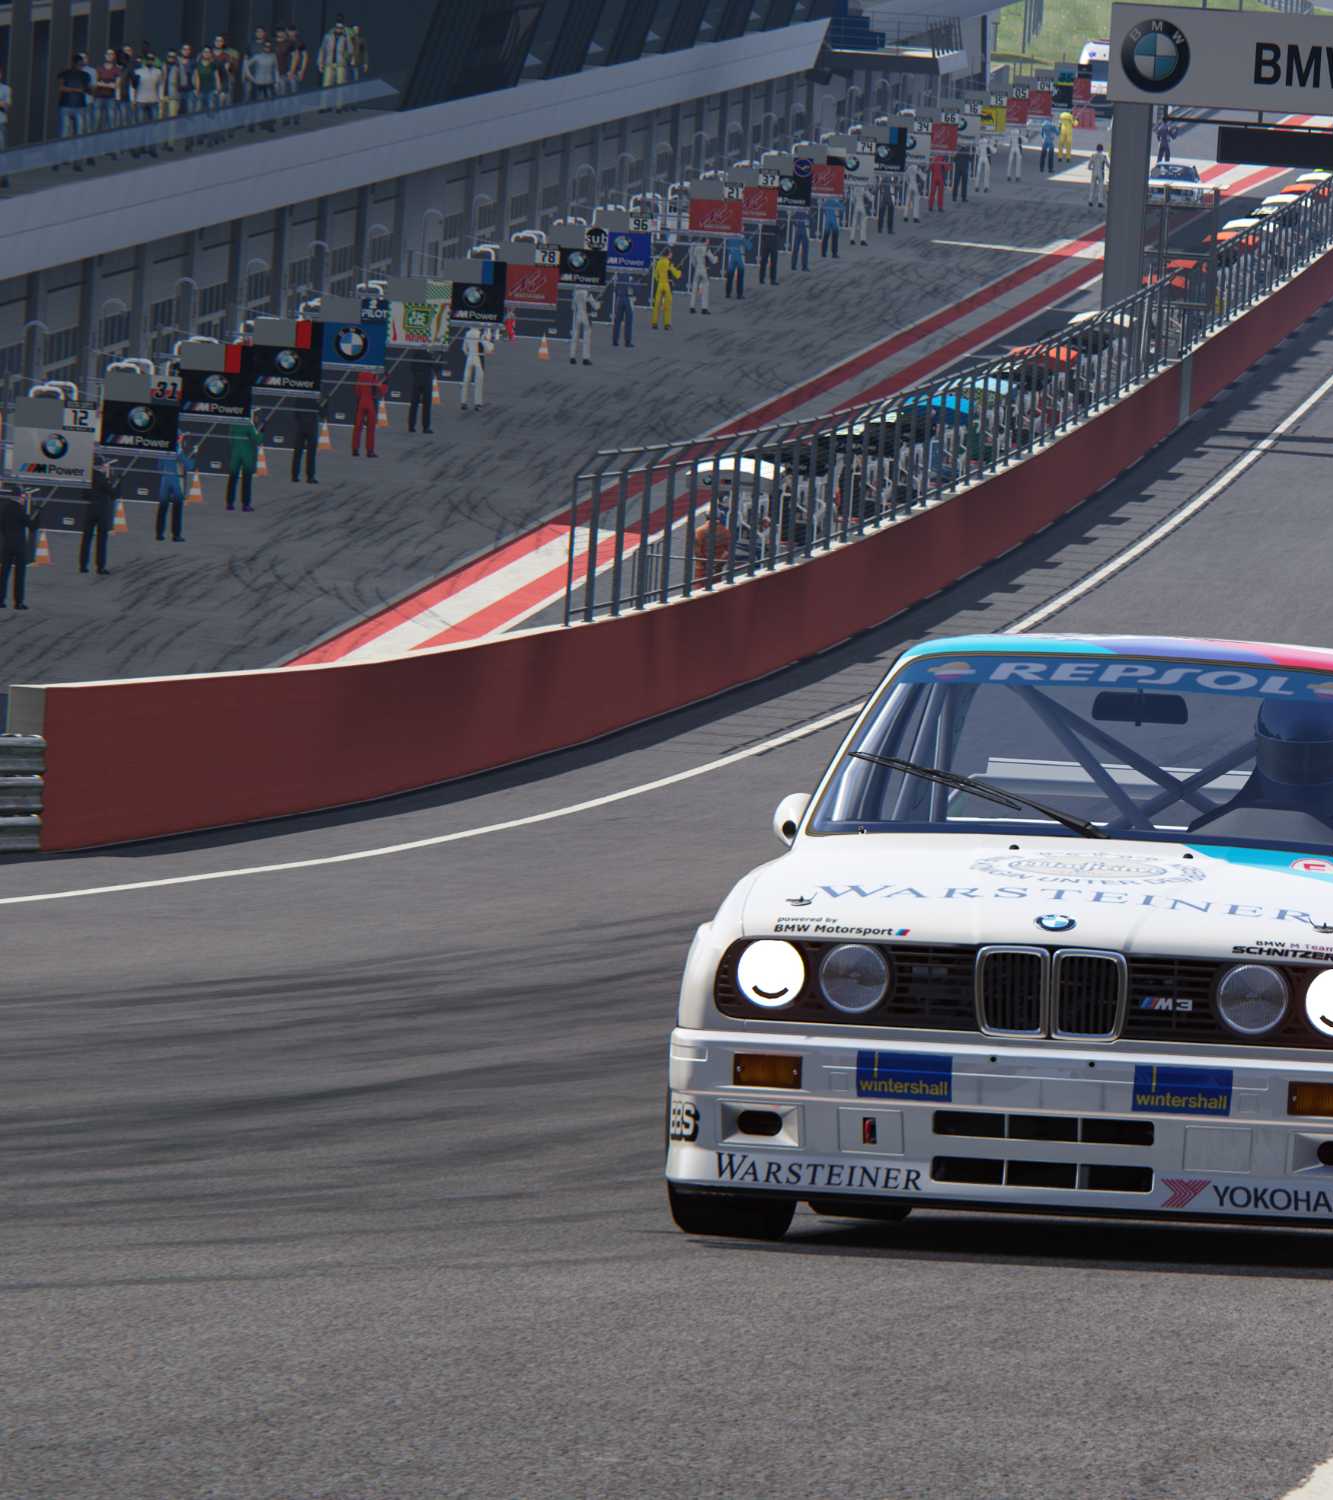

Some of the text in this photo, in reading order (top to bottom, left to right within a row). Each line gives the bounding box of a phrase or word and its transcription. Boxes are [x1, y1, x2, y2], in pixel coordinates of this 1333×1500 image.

[990, 661, 1294, 696] REPSOL
[817, 885, 1311, 925] WARSTEINER
[774, 924, 892, 936] BMW Motorsport
[1256, 940, 1286, 948] BMW
[1153, 998, 1193, 1012] M3
[859, 1078, 949, 1097] wintershall
[1136, 1092, 1228, 1111] wintershall
[715, 1152, 923, 1191] WARSTEINER
